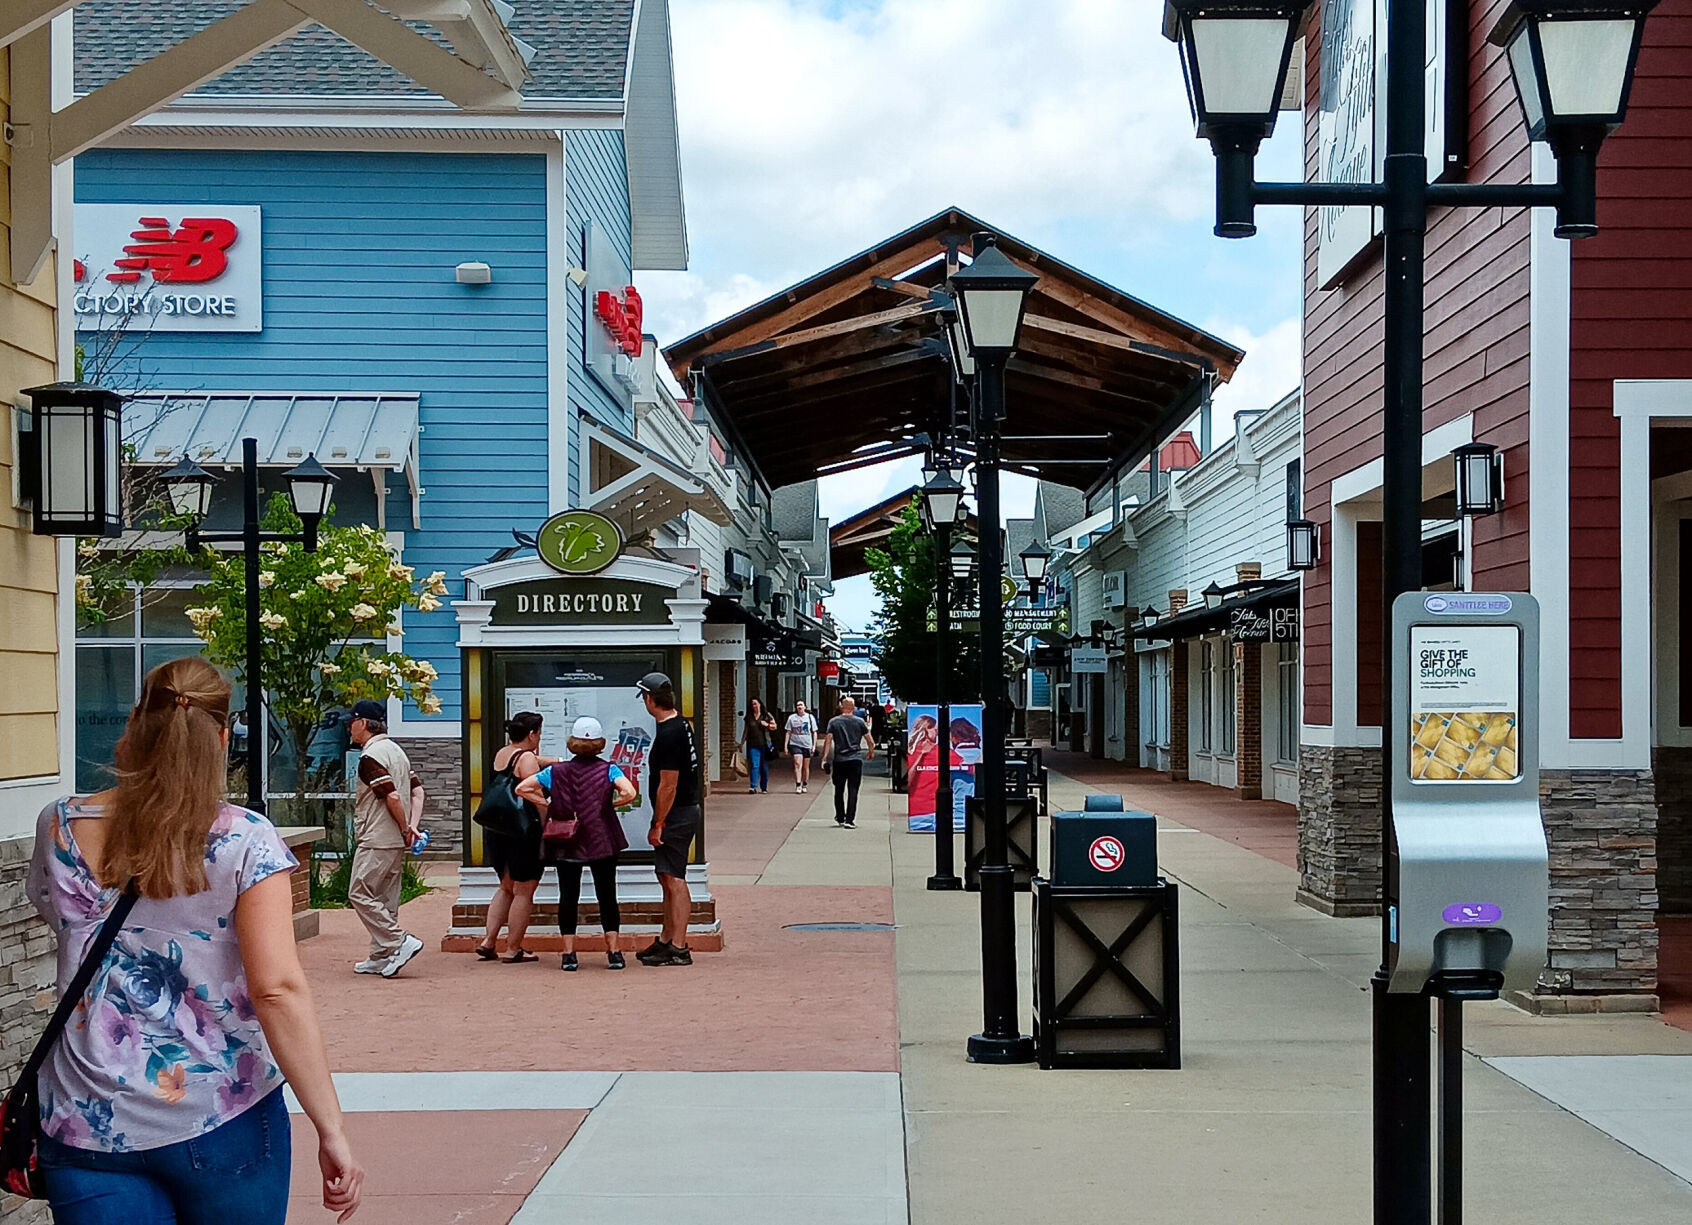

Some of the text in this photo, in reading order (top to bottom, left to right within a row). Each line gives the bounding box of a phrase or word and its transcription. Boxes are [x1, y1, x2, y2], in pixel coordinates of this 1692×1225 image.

[161, 294, 236, 316] STORE
[517, 594, 643, 613] DIRECTORY
[1420, 649, 1468, 660] GIVE THE
[1420, 659, 1462, 668] GIFT OF
[1420, 668, 1476, 678] SHOPPING
